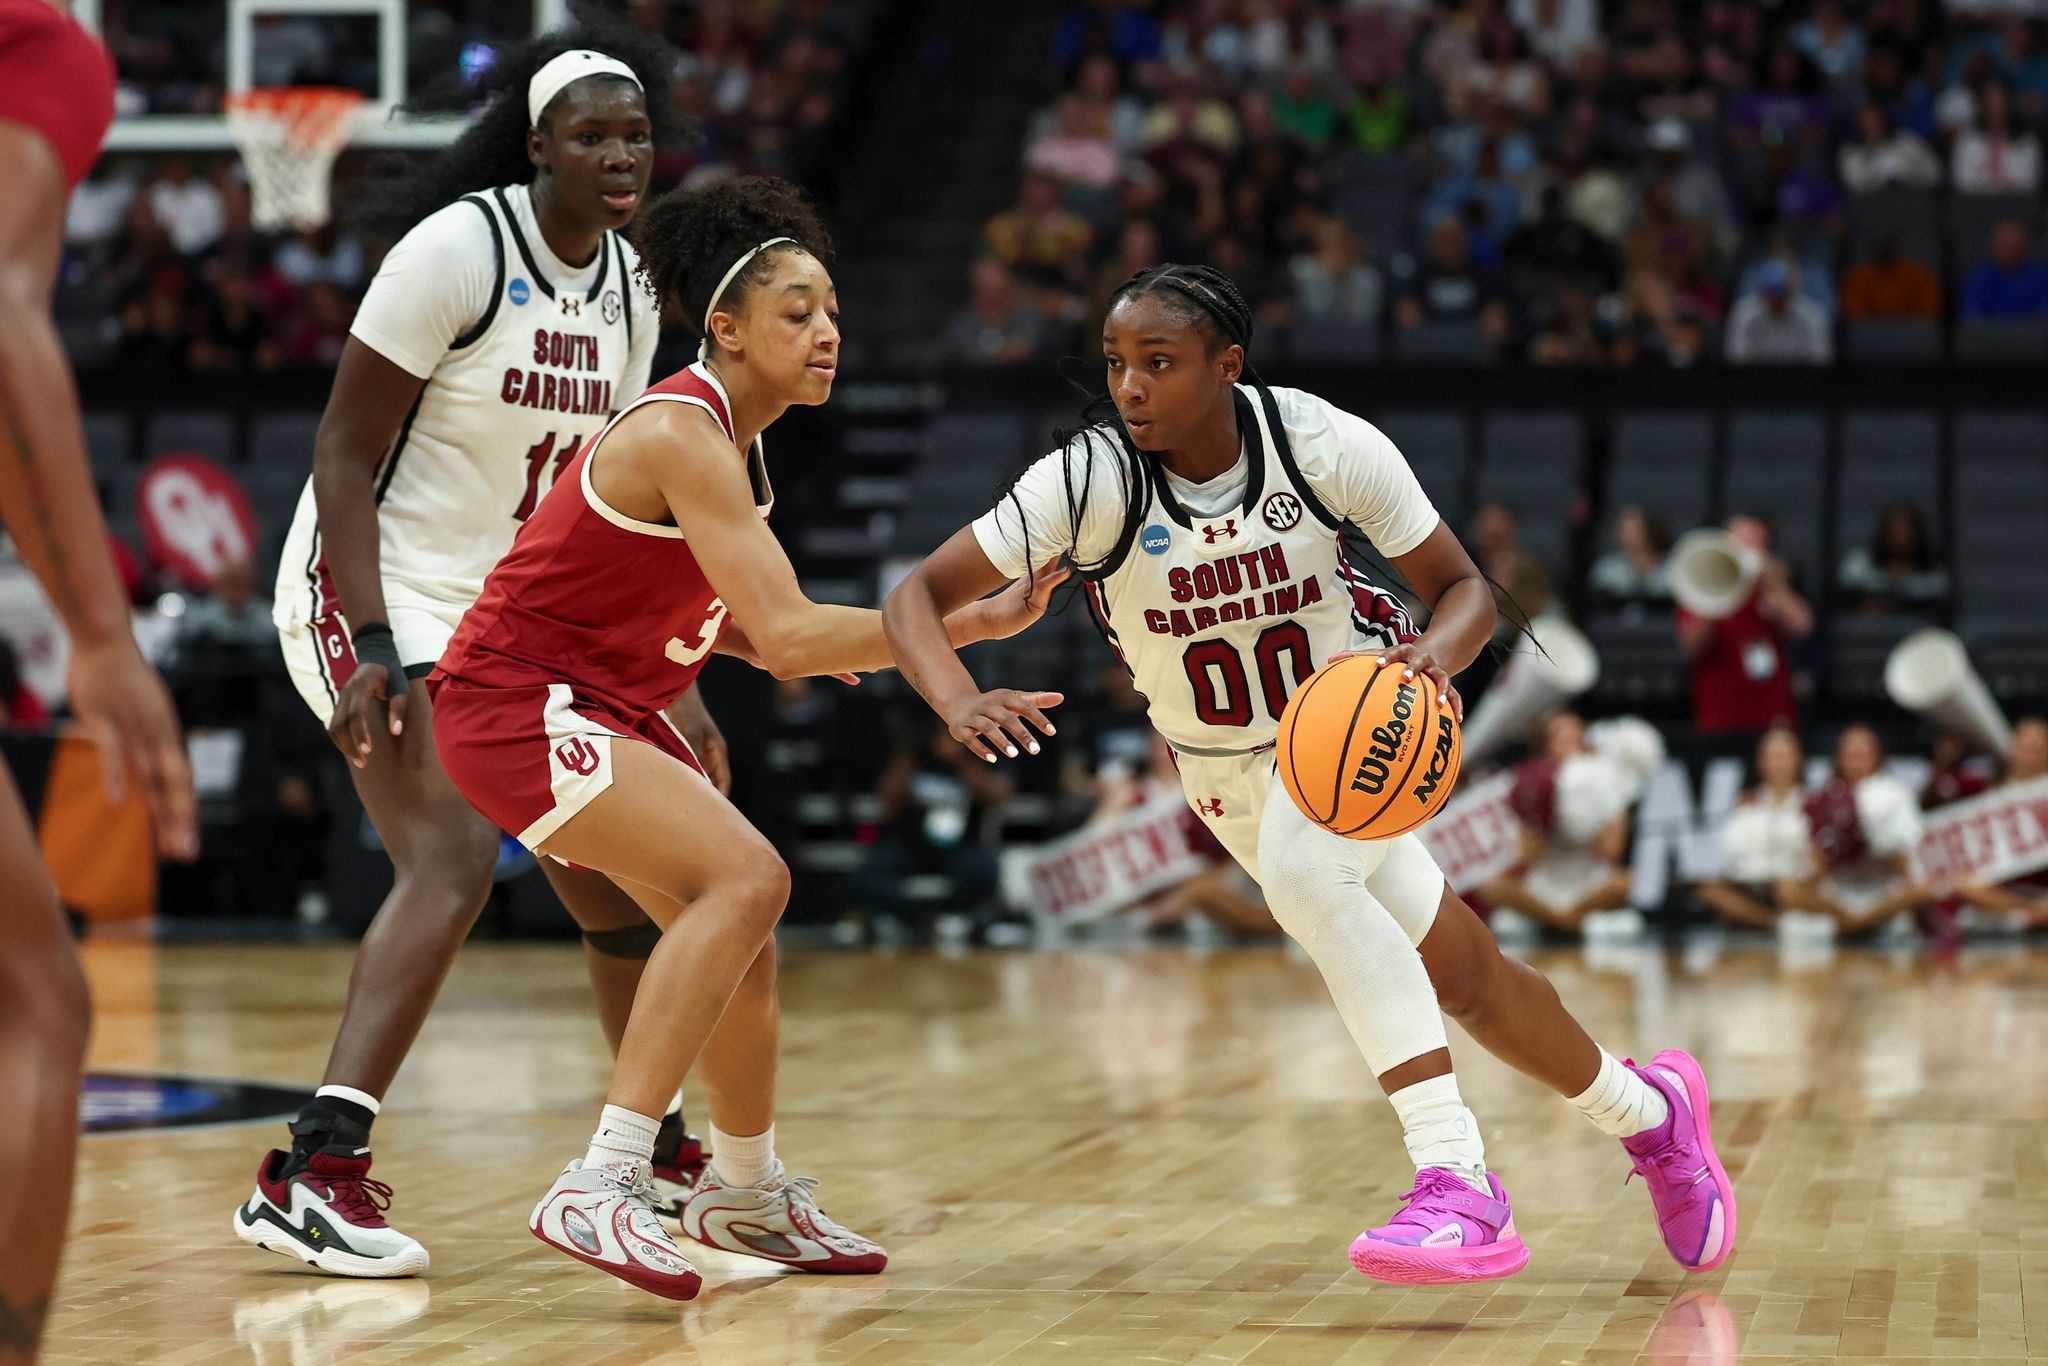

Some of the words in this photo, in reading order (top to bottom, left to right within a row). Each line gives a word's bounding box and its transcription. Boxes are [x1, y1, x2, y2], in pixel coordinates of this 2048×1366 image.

[534, 328, 598, 371] SOUTH
[1265, 493, 1300, 530] SEC
[1144, 537, 1169, 549] NCAA
[1168, 542, 1290, 602] SOUTH
[664, 596, 728, 667] 3
[1144, 574, 1323, 638] CAROLINA
[327, 634, 343, 659] C
[1182, 619, 1316, 727] 00
[555, 737, 600, 776] OU
[1350, 683, 1417, 795] Wilson
[1398, 744, 1408, 762] EVO
[1405, 724, 1415, 743] NXT
[1413, 714, 1453, 805] NCAA
